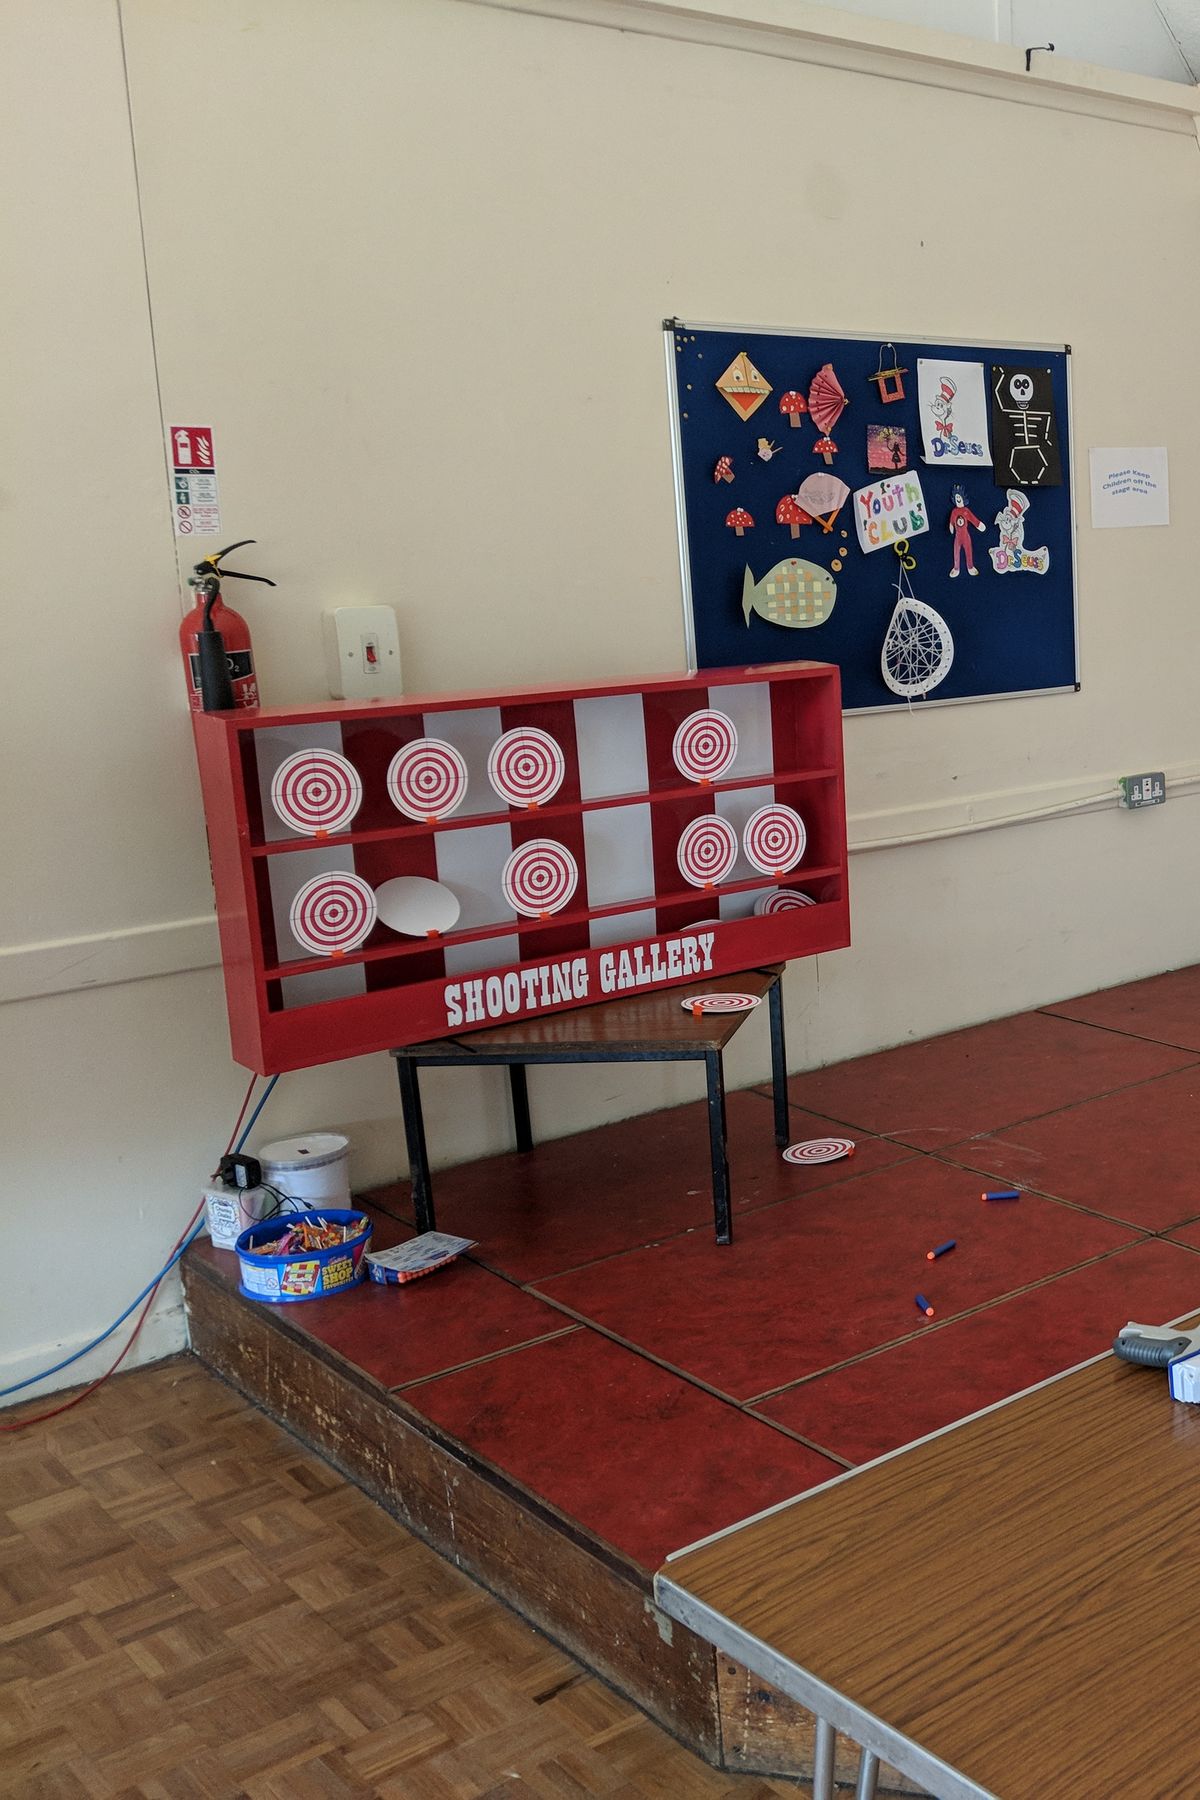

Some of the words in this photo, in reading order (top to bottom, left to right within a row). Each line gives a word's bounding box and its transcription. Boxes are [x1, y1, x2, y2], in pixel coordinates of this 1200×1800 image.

[1102, 478, 1131, 490] Children
[444, 957, 590, 1027] SHOOTING
[599, 932, 716, 994] GALLERY
[322, 1267, 354, 1286] SHOP
